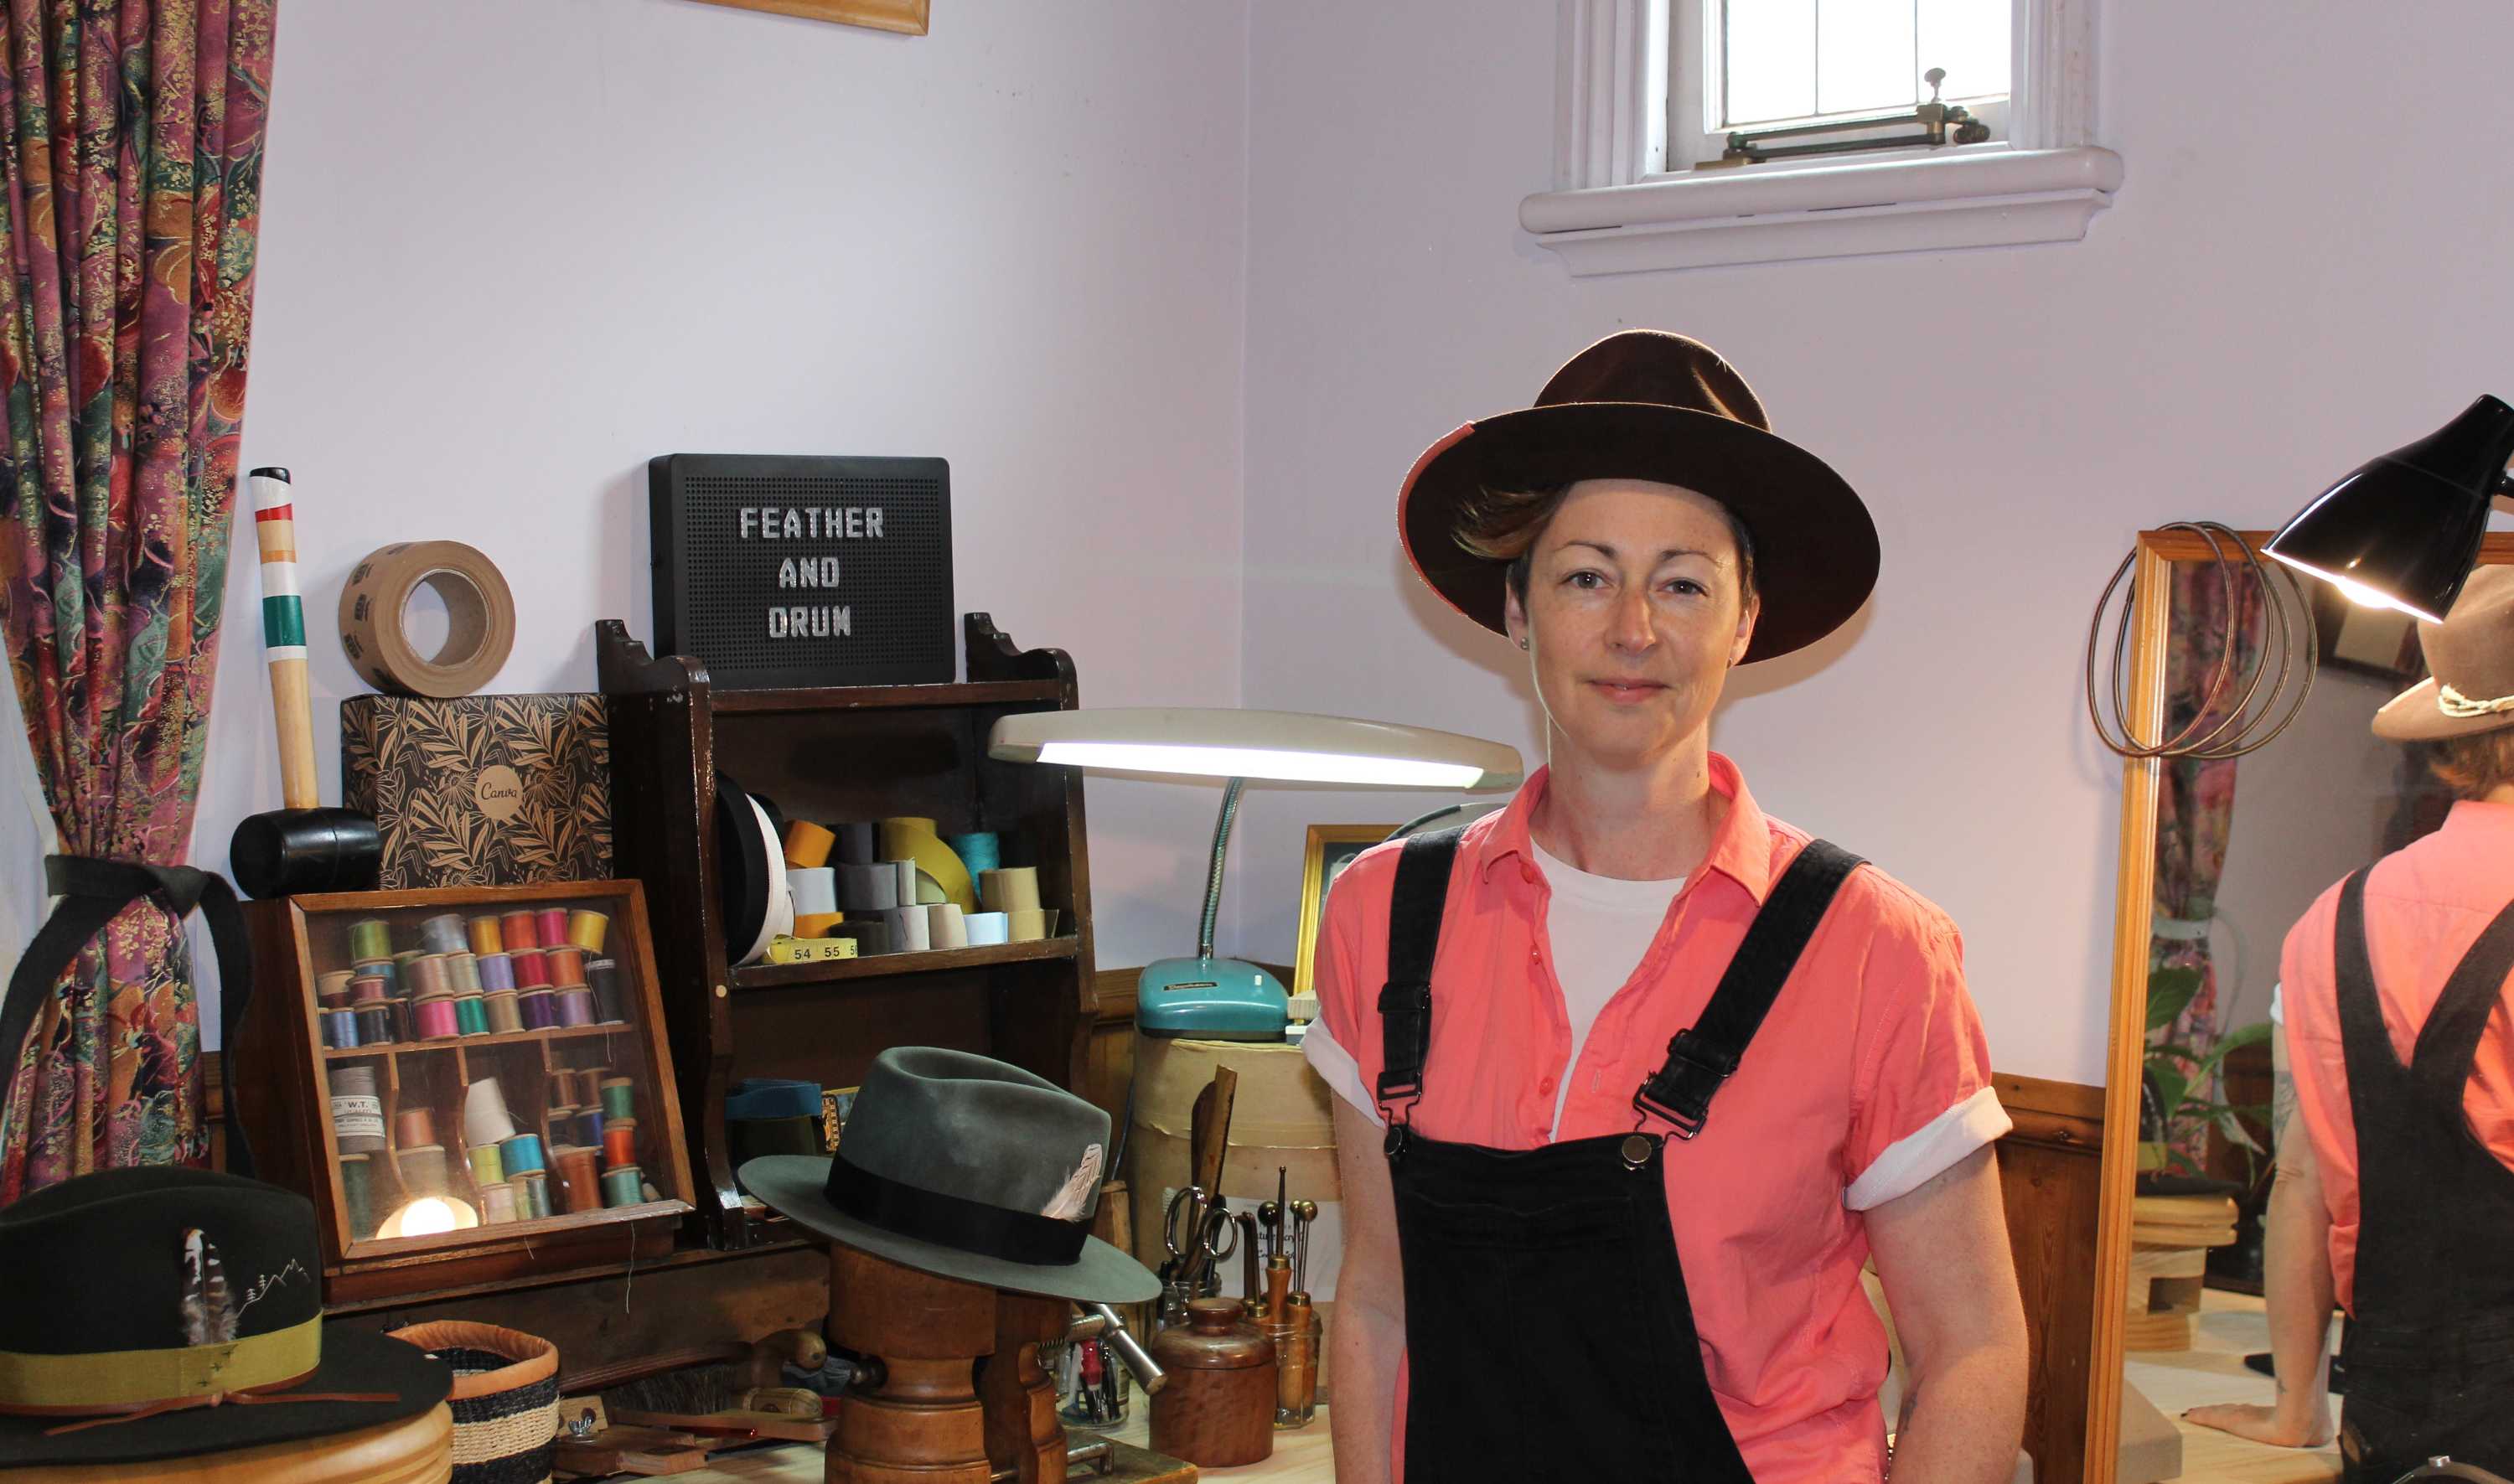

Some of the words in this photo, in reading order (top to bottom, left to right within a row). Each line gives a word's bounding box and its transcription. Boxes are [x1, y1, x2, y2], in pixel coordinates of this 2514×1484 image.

[740, 507, 883, 539] FEATHER
[779, 556, 840, 588] AND
[768, 605, 851, 639] DRUM
[481, 781, 518, 800] Canva
[794, 949, 811, 959] 54
[825, 946, 840, 958] 55
